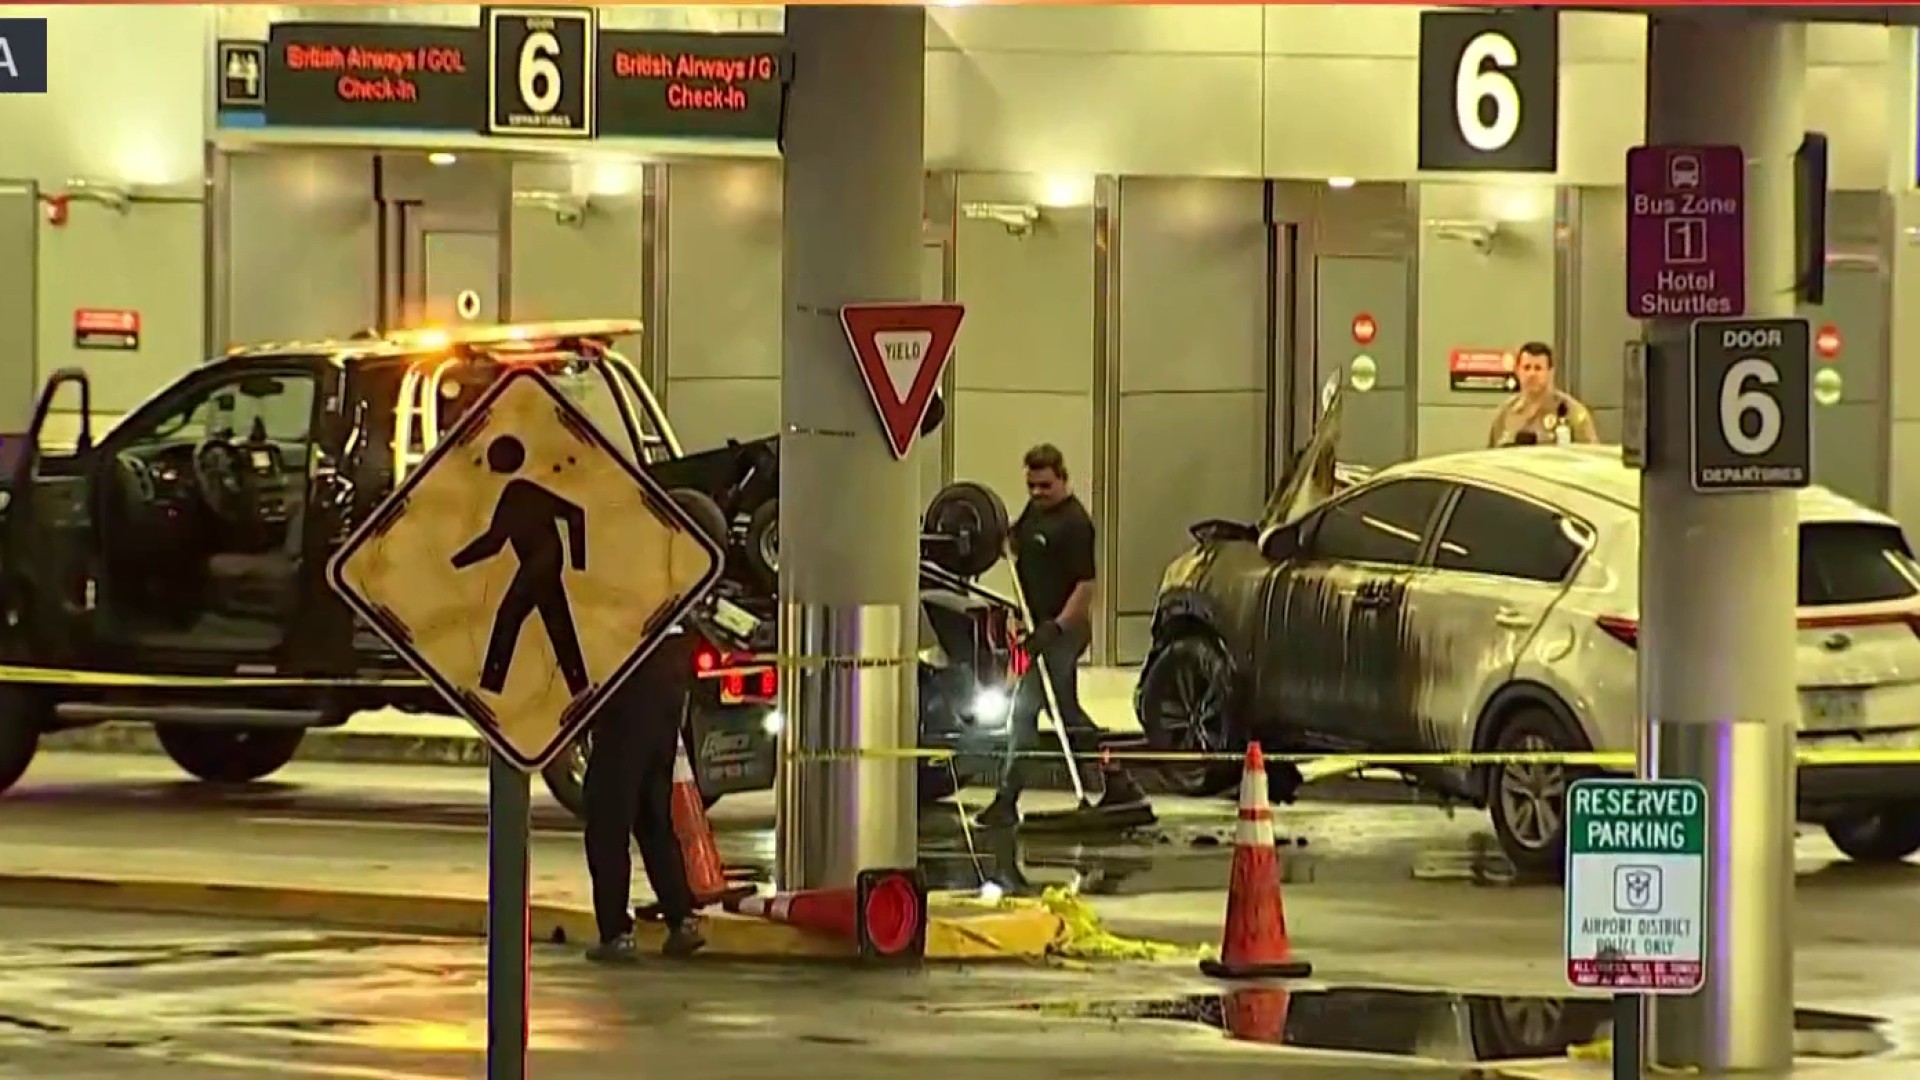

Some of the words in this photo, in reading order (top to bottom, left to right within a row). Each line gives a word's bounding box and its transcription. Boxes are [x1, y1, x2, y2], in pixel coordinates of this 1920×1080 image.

[287, 45, 345, 68] British
[347, 47, 415, 73] Airways
[519, 31, 561, 112] 6
[615, 52, 673, 77] British
[676, 54, 745, 83] Airways
[1457, 32, 1520, 151] 6
[1634, 193, 1676, 215] Bus
[1681, 194, 1737, 214] Zone
[1675, 222, 1691, 258] 1
[1657, 270, 1715, 290] Hotel
[1641, 293, 1732, 314] Shuttles
[885, 341, 921, 361] YIELD
[1723, 329, 1782, 348] DOOR
[1719, 358, 1782, 455] 6
[1702, 467, 1803, 482] DEPARTURES
[1575, 788, 1698, 816] RESERVED
[1587, 820, 1685, 848] PARKING
[1581, 918, 1632, 935] AIRPORT
[1637, 918, 1691, 937] DISTRICT
[1643, 939, 1674, 955] ONLY
